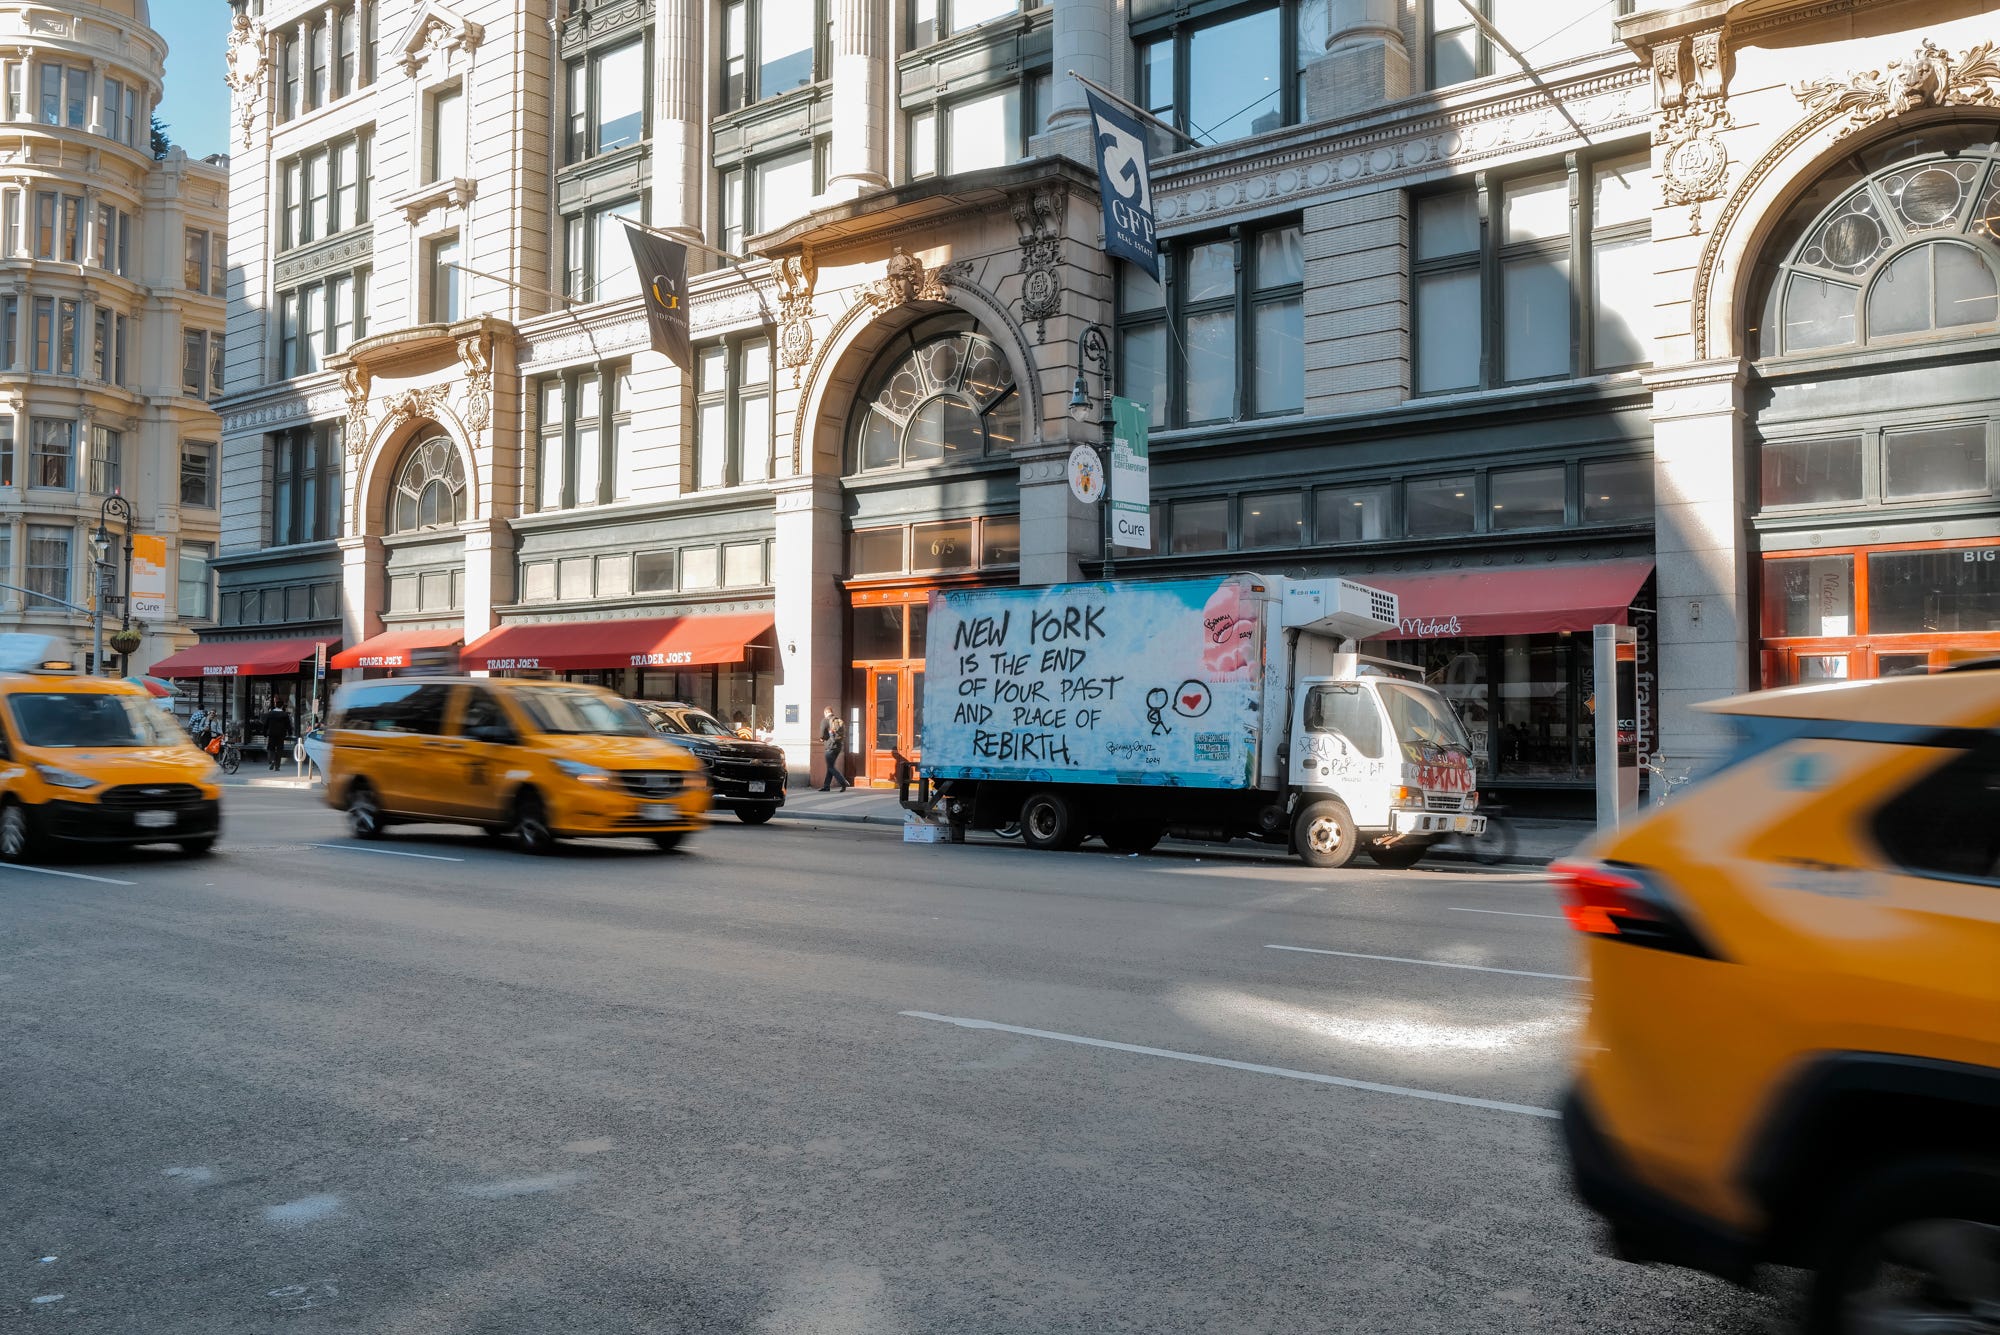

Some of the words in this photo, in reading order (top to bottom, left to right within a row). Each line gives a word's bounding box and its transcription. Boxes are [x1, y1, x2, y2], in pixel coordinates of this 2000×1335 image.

[1112, 200, 1154, 245] GFP
[1117, 231, 1133, 247] REAL
[1134, 241, 1153, 259] ESTATE
[1963, 550, 1996, 563] BIG
[953, 610, 1009, 650] NEW
[1030, 605, 1107, 645] YORK
[1399, 615, 1462, 638] Michaels
[1634, 587, 1652, 665] ustom
[203, 665, 223, 675] TRADER
[223, 664, 238, 675] JOE'S
[359, 657, 383, 667] TRADER
[383, 656, 403, 665] JOE'S
[486, 658, 515, 670] TRADER
[516, 657, 539, 669] JOE'S
[630, 653, 664, 666] TRADER
[665, 651, 692, 664] JOE'S
[960, 653, 979, 676] IS
[990, 652, 1031, 677] THE
[1040, 647, 1087, 673] END
[958, 678, 987, 698] OF
[994, 678, 1050, 704] YOUR
[1060, 676, 1124, 702] PAST
[953, 703, 993, 725] AND
[1013, 706, 1067, 729] PLACE
[1075, 709, 1101, 729] OF
[972, 729, 1080, 766] REBIRTH.
[1145, 757, 1160, 765] 2024
